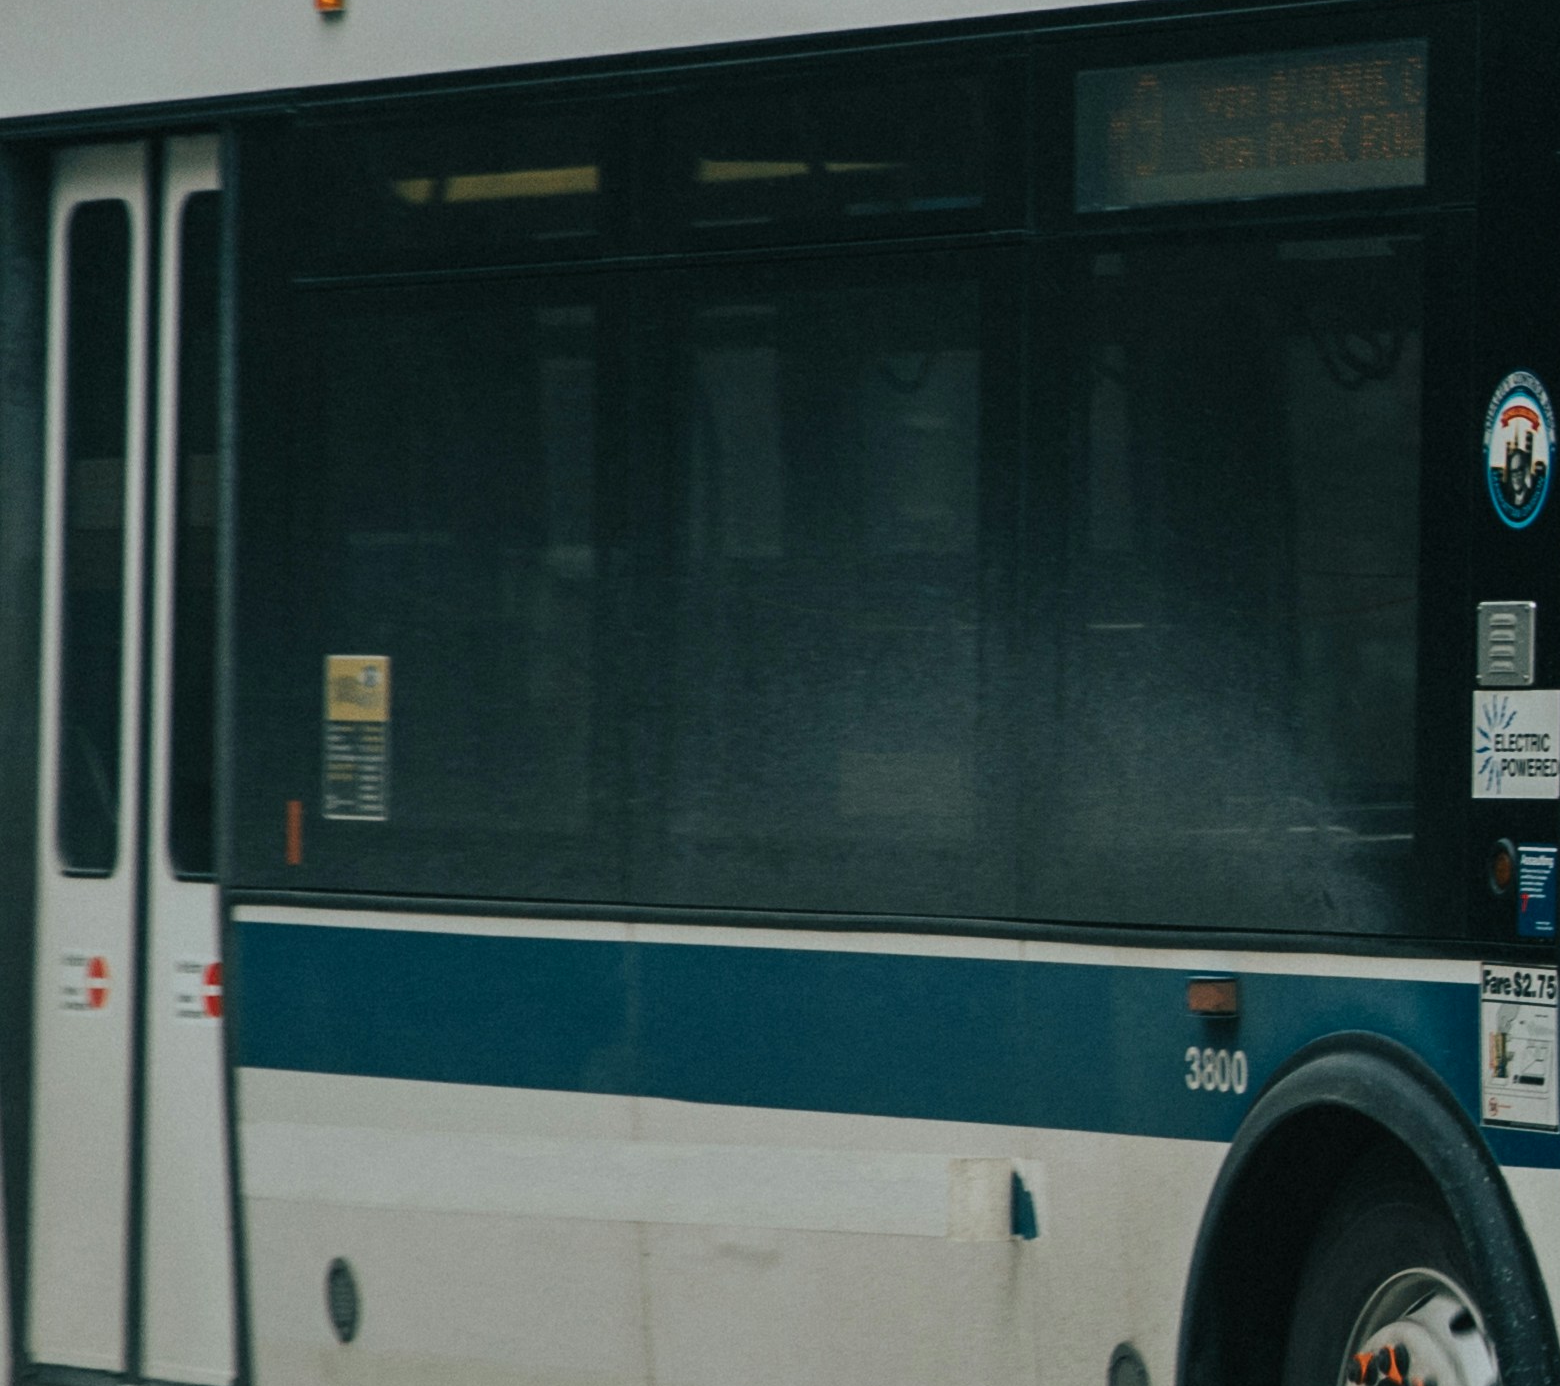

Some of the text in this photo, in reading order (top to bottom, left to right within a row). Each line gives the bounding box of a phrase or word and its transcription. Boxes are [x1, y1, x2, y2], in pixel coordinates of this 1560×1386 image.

[1494, 733, 1551, 754] ELECTRIC
[1501, 757, 1559, 778] POWERED
[1482, 969, 1557, 1000] Fare $2.75
[1184, 1045, 1249, 1095] 3800
